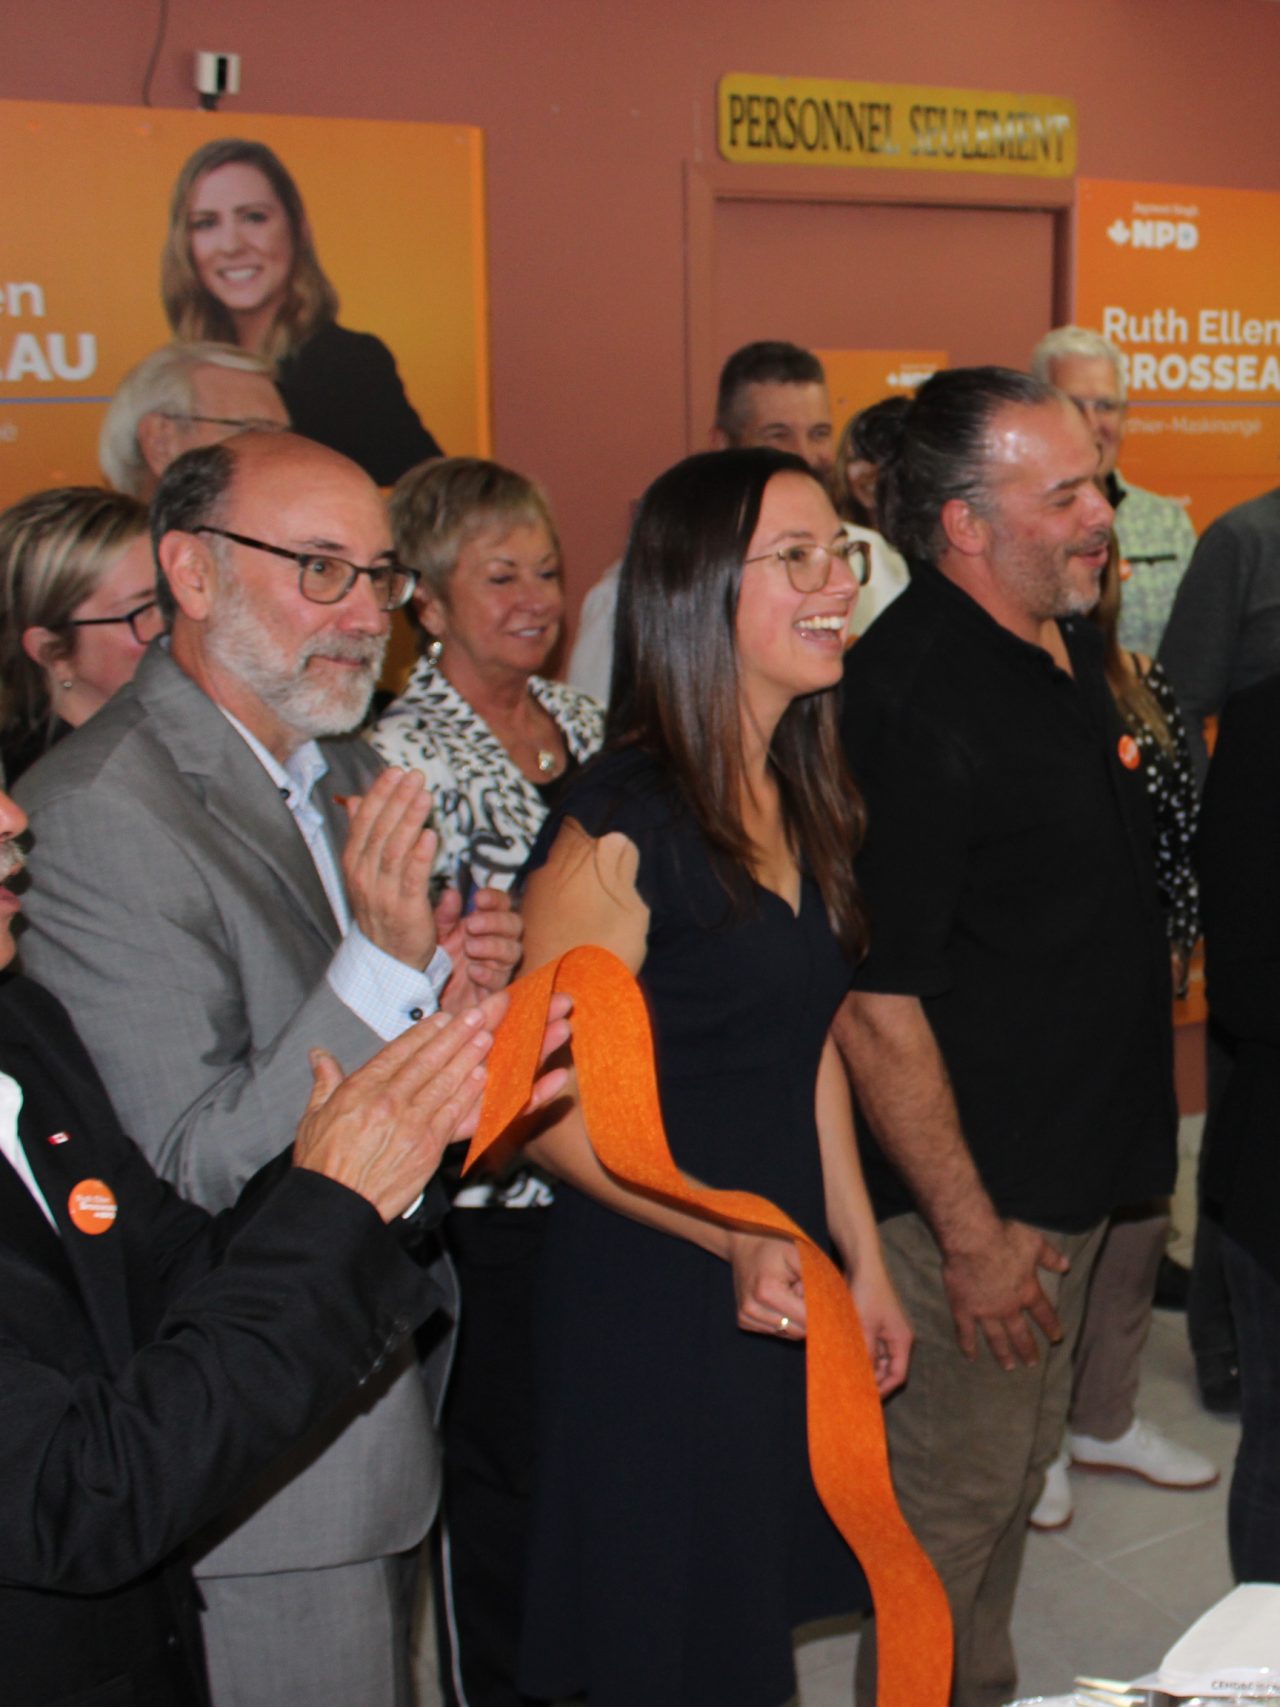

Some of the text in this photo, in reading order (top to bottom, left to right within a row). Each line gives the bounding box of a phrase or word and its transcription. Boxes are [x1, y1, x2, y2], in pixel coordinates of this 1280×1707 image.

[728, 93, 1070, 163] PERSONNEL SEULEMENT
[1132, 219, 1198, 249] NPD
[1103, 306, 1188, 343] Ruth
[0, 331, 97, 382] AU
